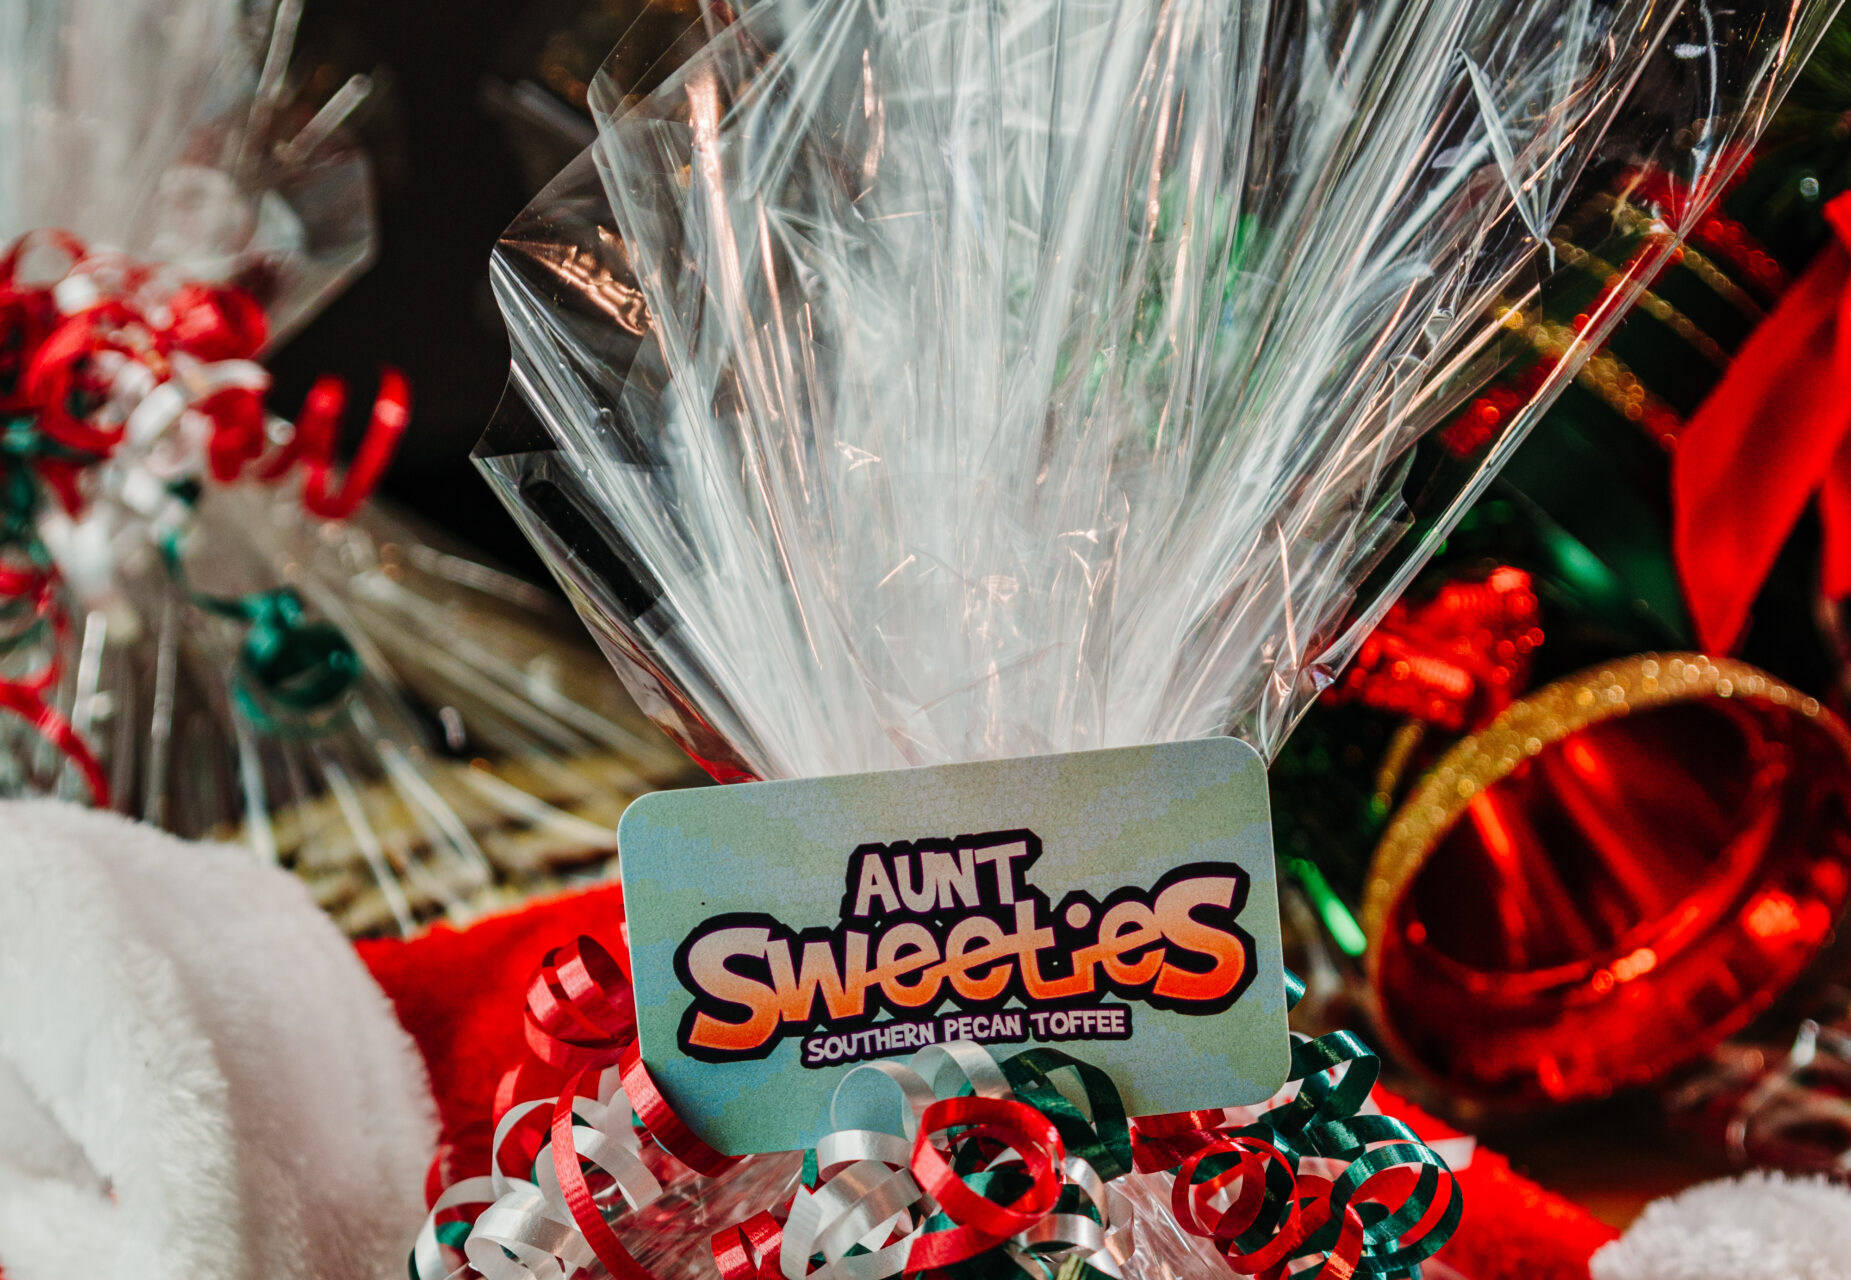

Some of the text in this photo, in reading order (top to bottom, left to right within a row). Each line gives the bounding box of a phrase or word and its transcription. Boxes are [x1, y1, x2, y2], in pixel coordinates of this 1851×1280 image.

[854, 841, 1028, 915] AUNT
[807, 1009, 1125, 1062] SOUTHERN PECAN TOFFEE
